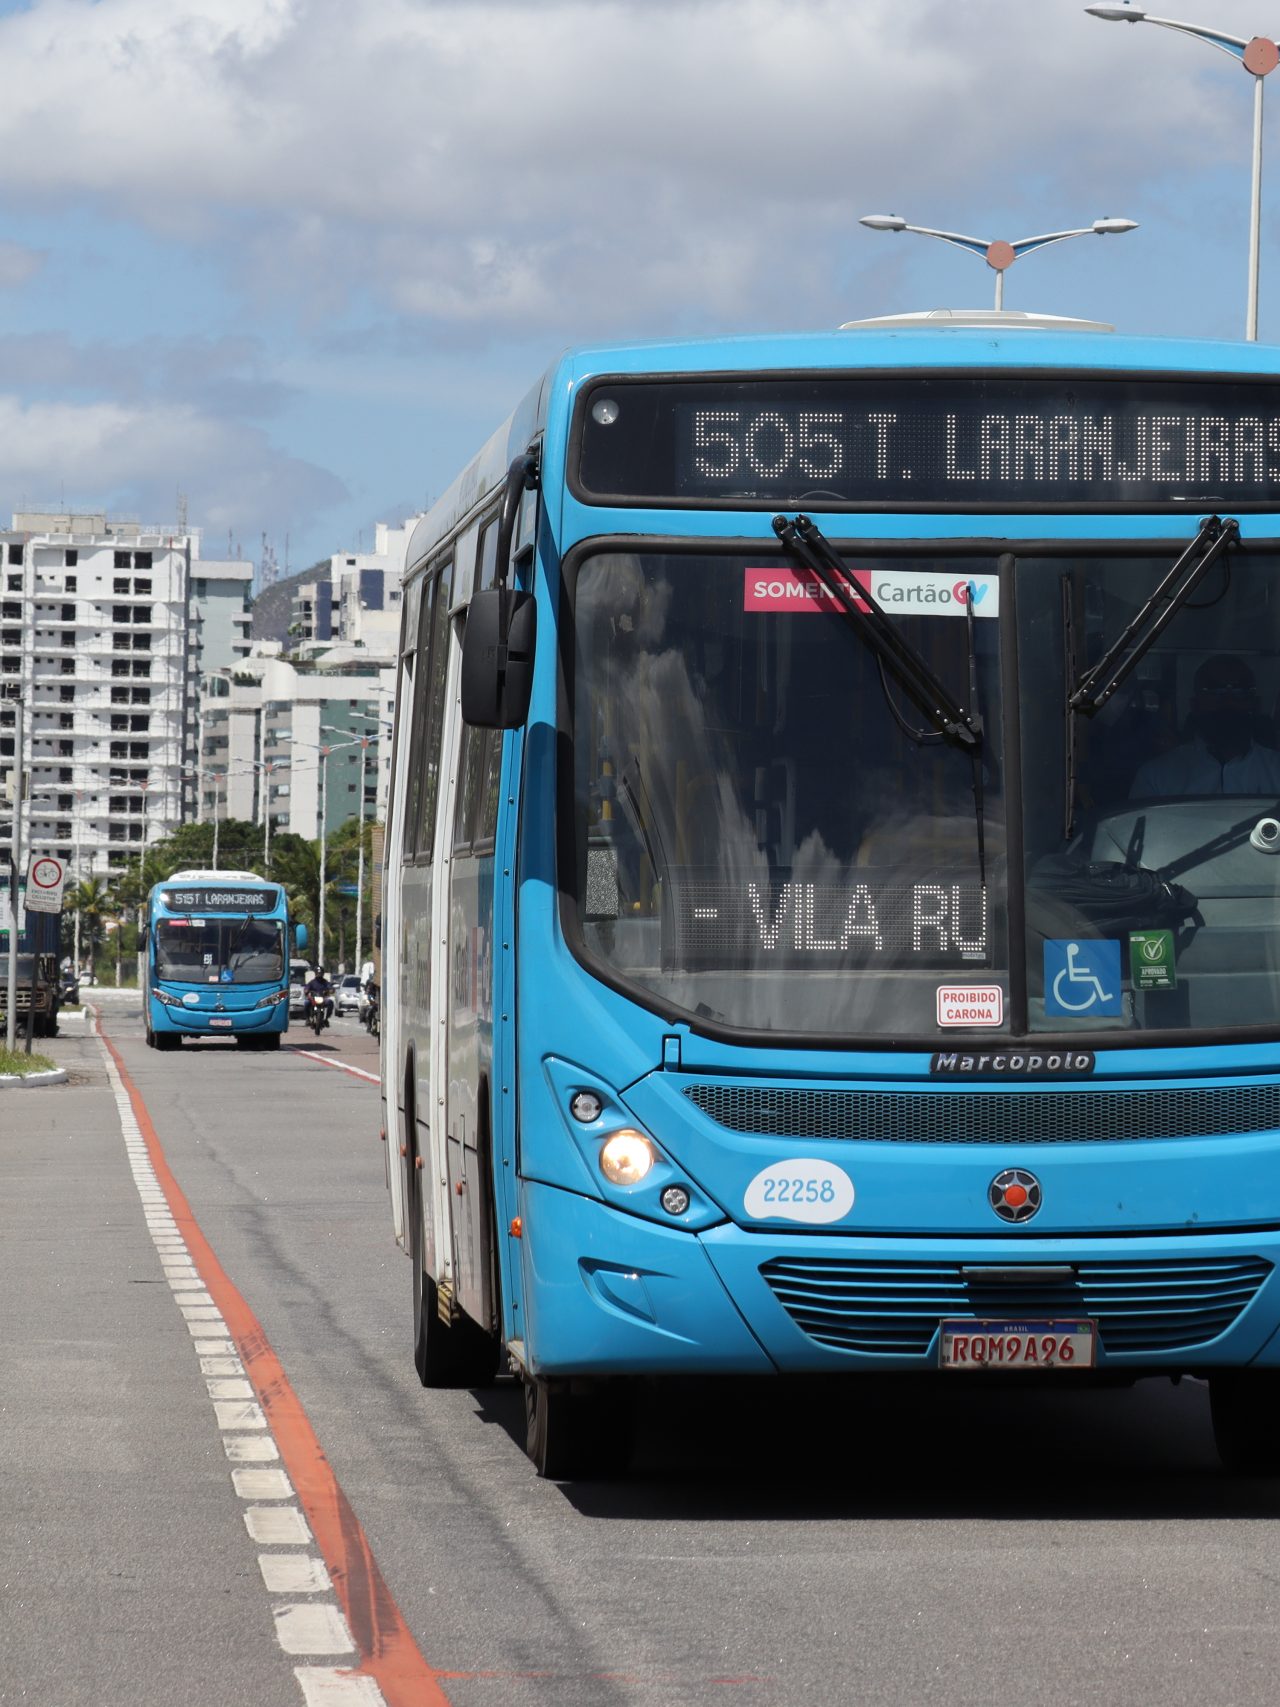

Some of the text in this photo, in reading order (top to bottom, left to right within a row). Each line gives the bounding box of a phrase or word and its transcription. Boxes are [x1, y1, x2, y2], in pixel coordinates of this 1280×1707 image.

[695, 411, 844, 479] 505
[868, 413, 912, 480] T.
[748, 883, 883, 950] VILA
[943, 992, 996, 1003] PROIBIDO
[946, 1008, 993, 1020] CARONA
[936, 1052, 1090, 1073] Marcopolo
[763, 1179, 835, 1203] 22258
[952, 1335, 1075, 1362] RQM9A96
